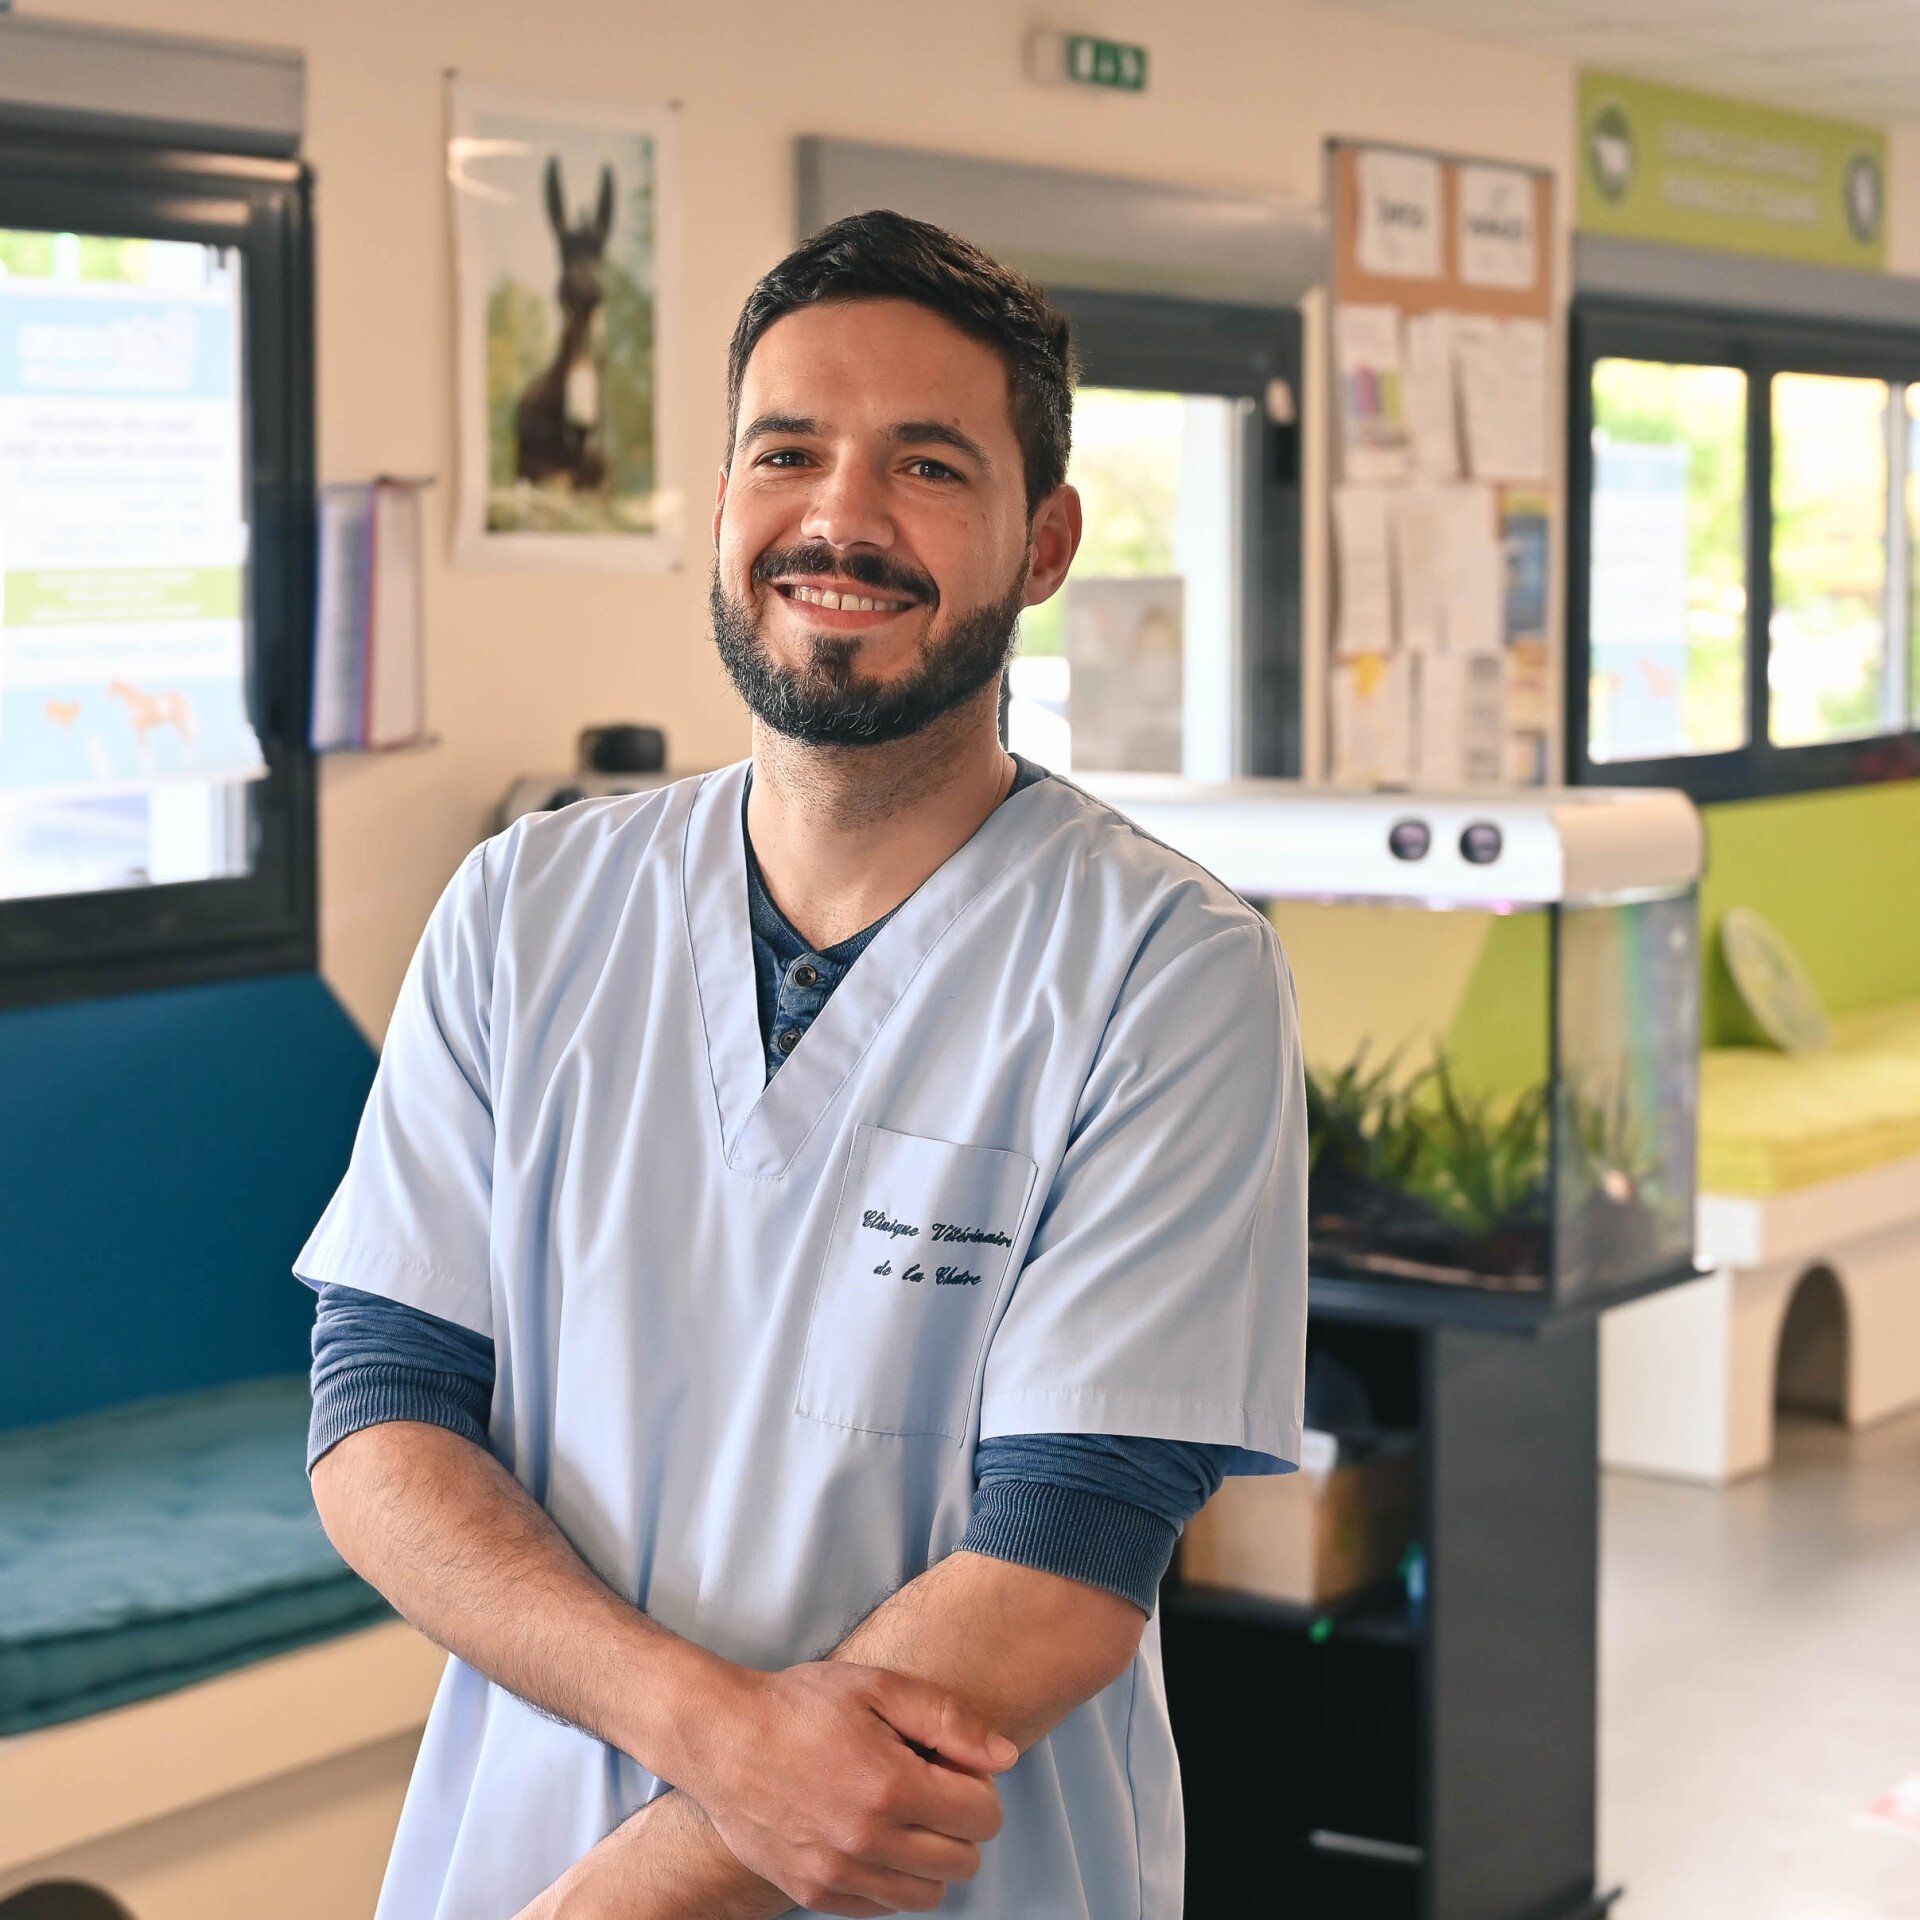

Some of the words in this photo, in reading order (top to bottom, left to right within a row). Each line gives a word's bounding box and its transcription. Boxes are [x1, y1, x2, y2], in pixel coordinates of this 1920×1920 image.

[862, 1210, 920, 1240] Clinique
[873, 1259, 892, 1276] de
[902, 1263, 926, 1283] la
